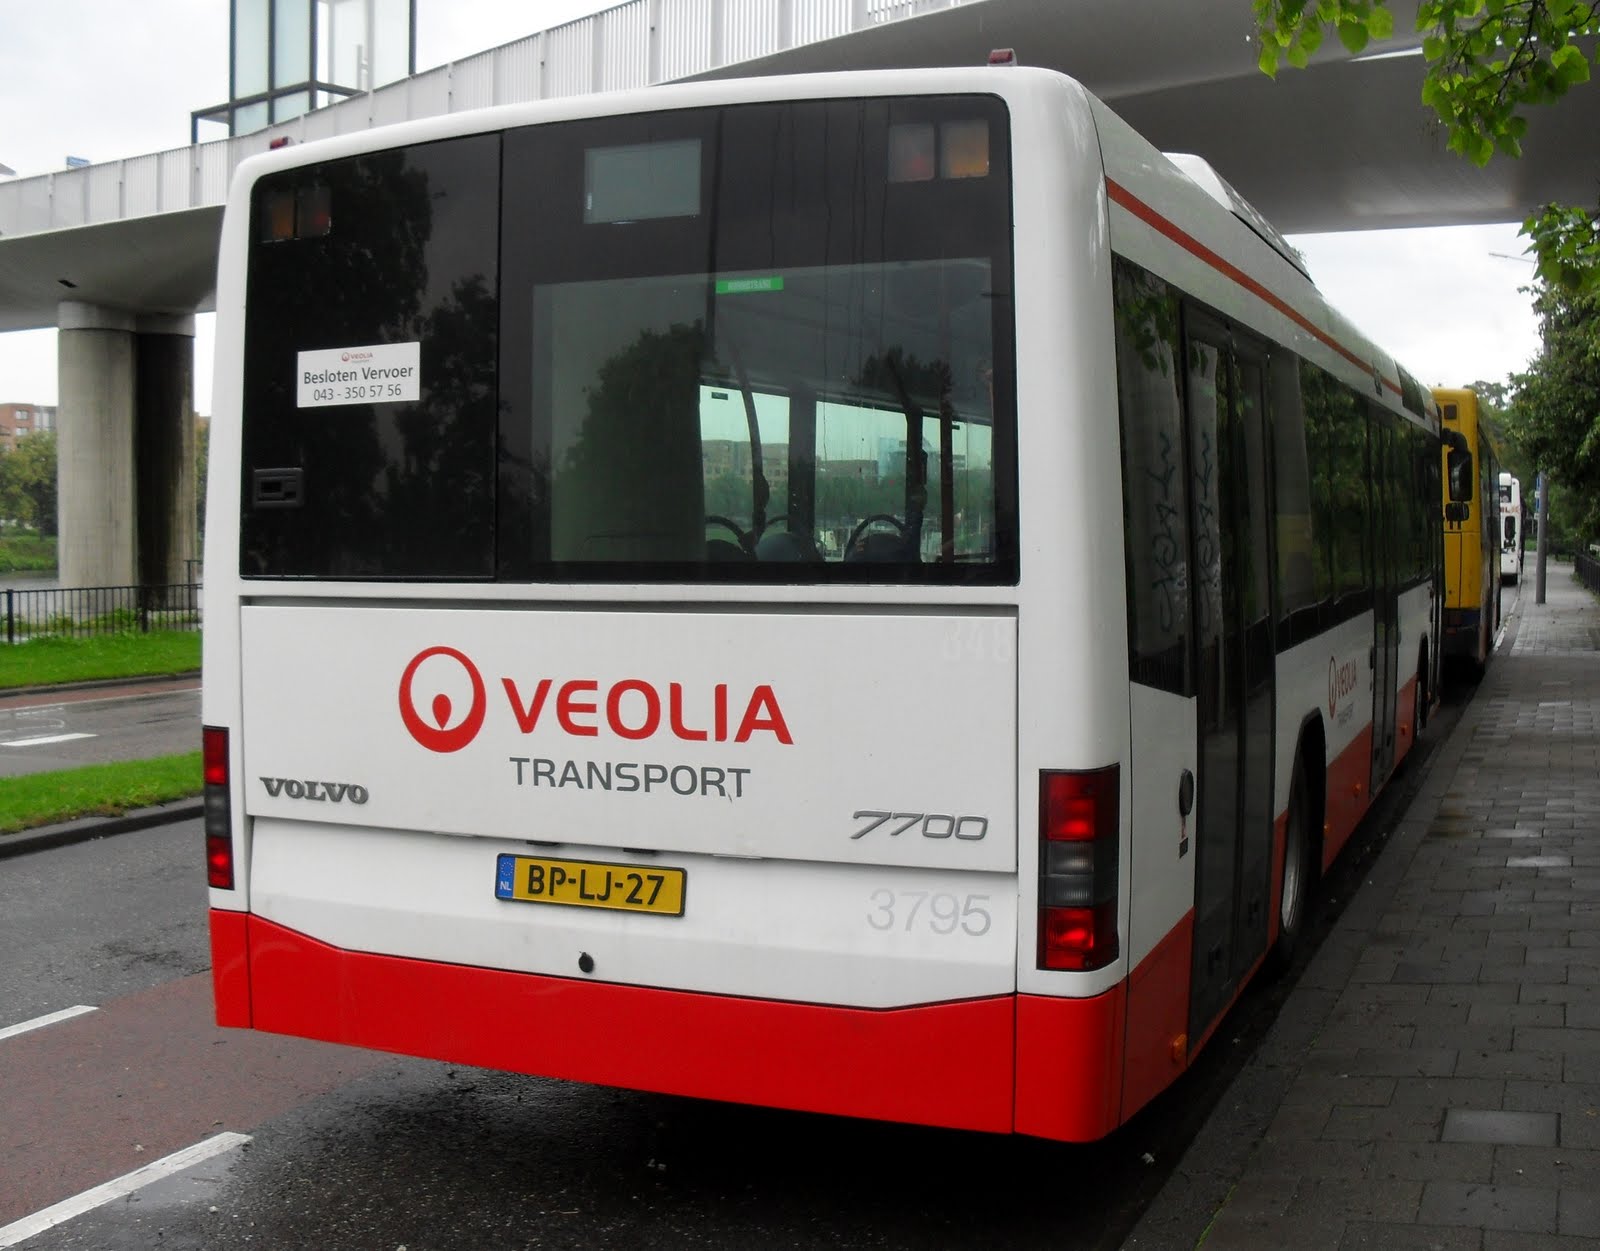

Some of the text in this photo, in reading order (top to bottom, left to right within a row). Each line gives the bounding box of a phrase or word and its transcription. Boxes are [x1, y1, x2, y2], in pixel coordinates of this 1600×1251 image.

[304, 366, 413, 384] Besloten Vervoer
[313, 388, 334, 401] 043
[344, 386, 366, 399] 350
[369, 385, 383, 397] 57
[387, 383, 402, 396] 56
[501, 678, 794, 745] VEOLIA
[259, 776, 369, 805] VOLVO
[509, 757, 751, 798] TRANSPORT
[850, 810, 988, 840] 7700
[499, 866, 666, 906] NL BP-LJ-27
[867, 888, 992, 937] 3795
